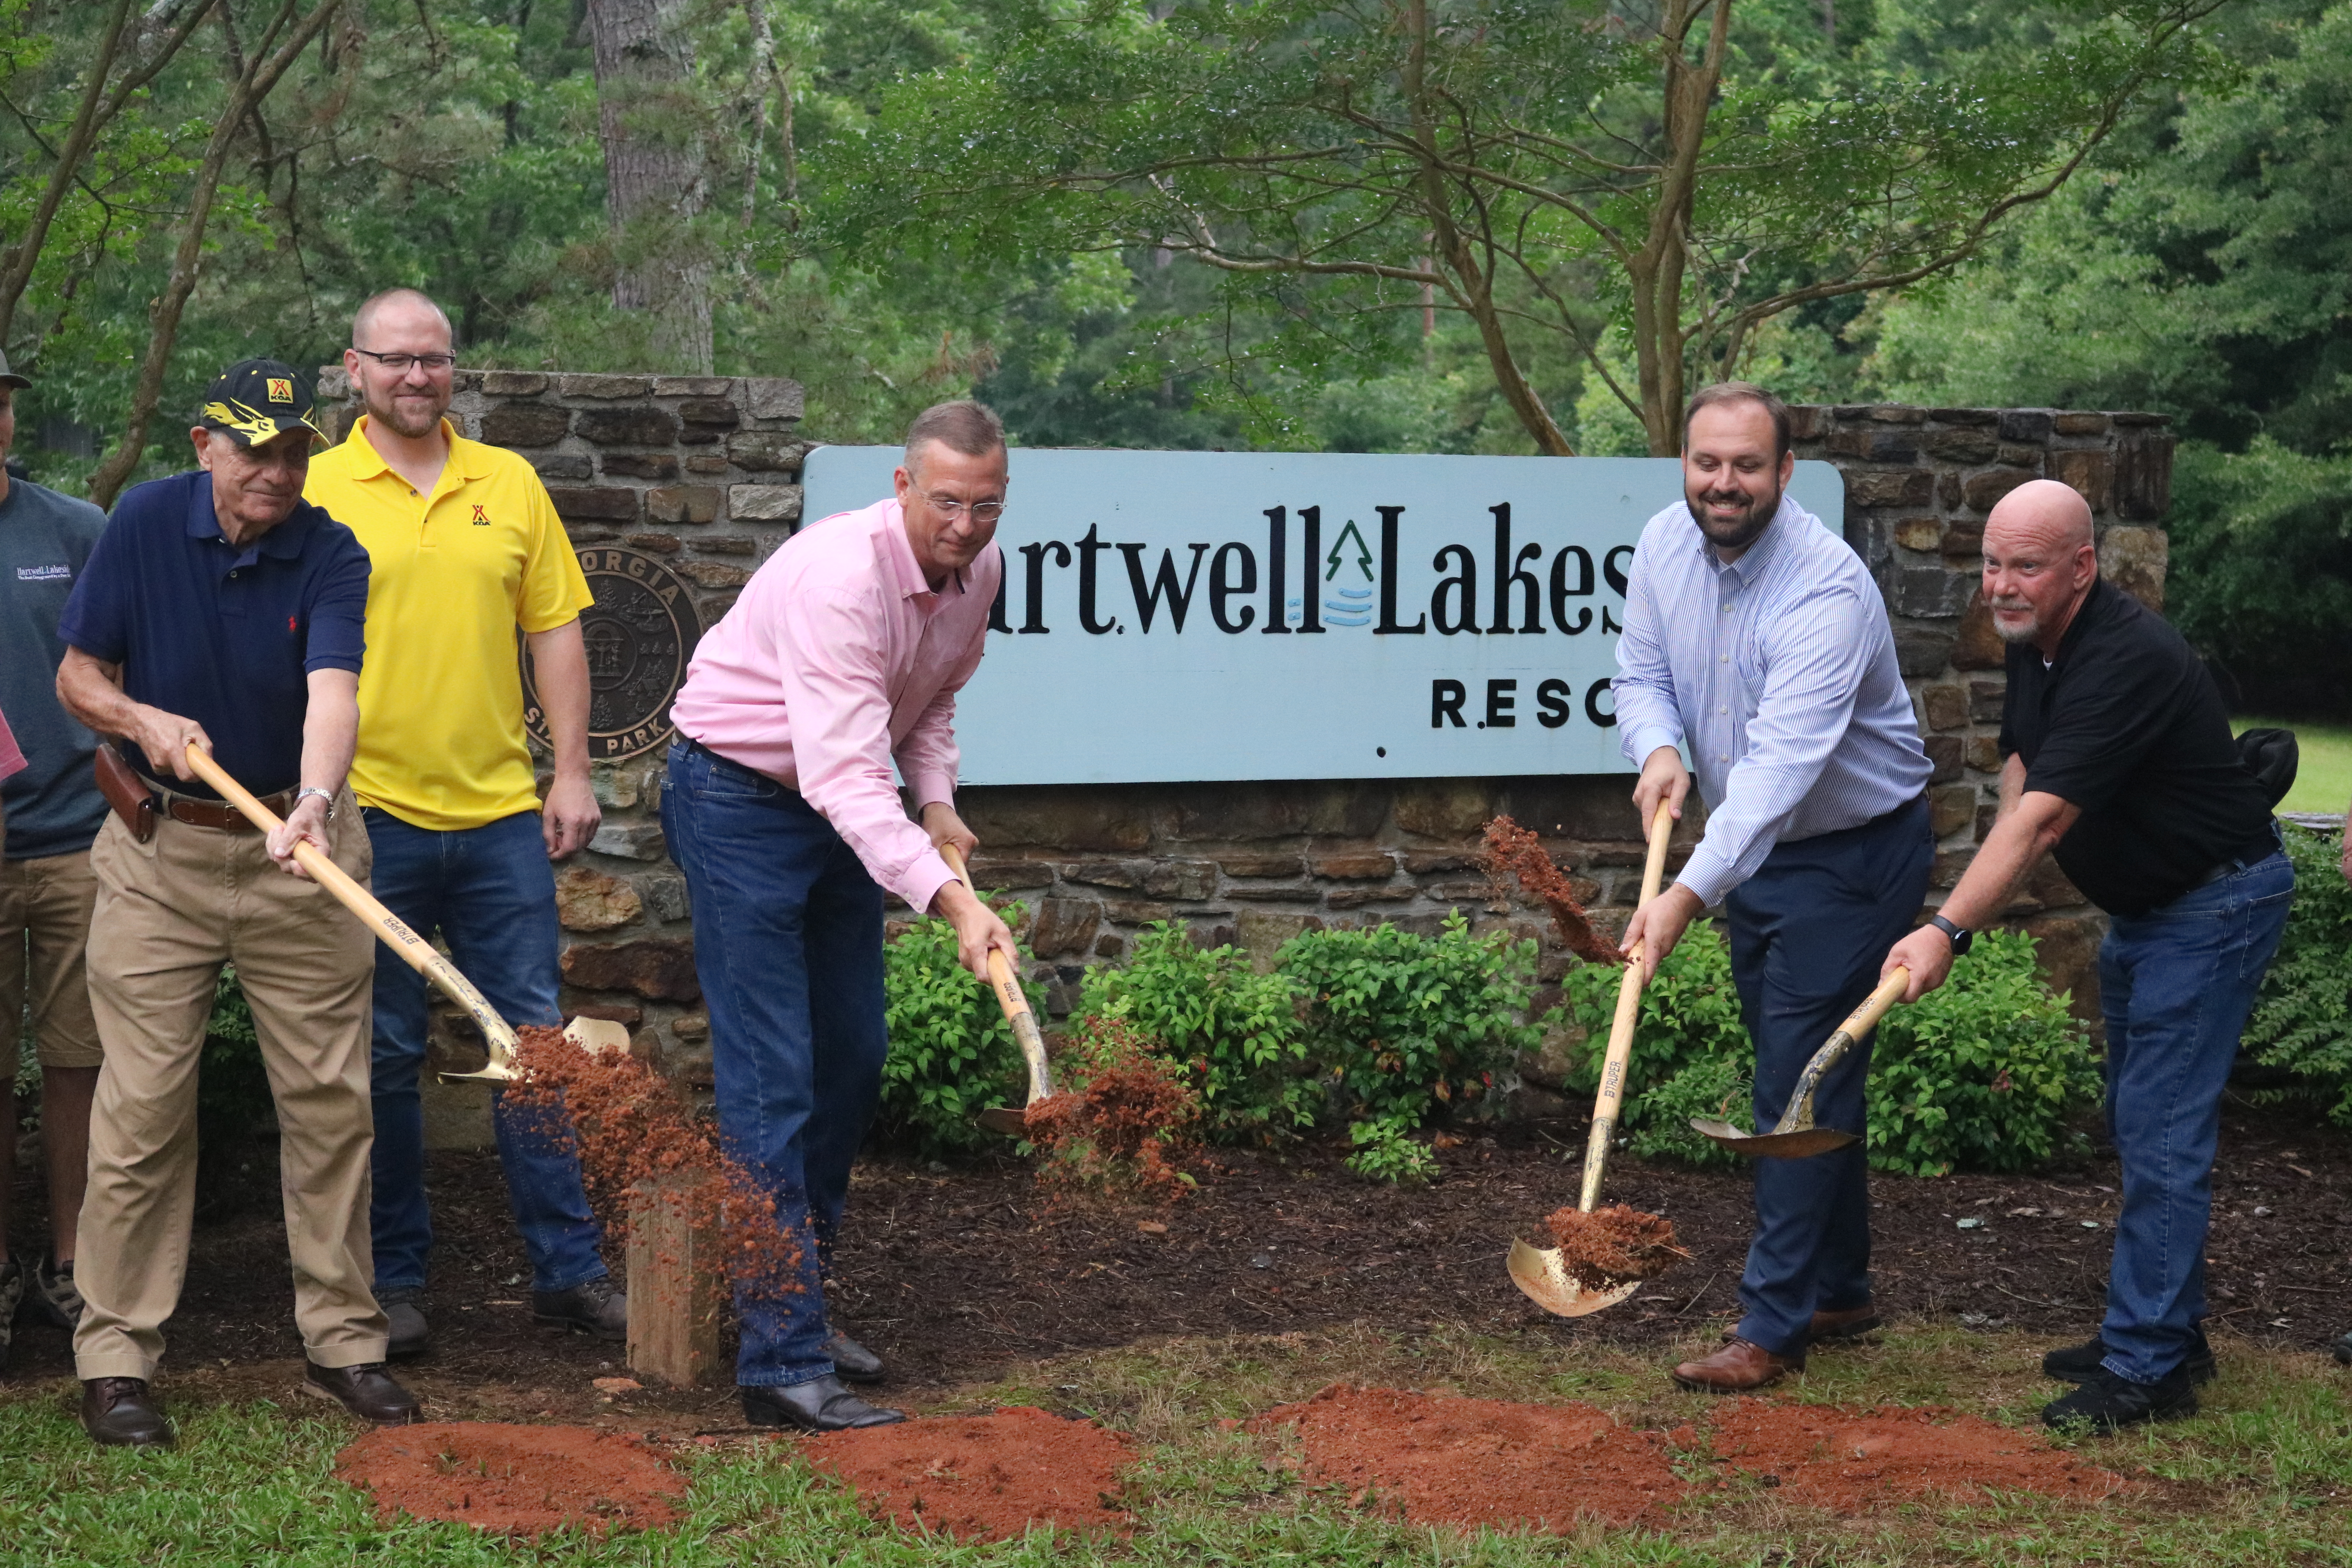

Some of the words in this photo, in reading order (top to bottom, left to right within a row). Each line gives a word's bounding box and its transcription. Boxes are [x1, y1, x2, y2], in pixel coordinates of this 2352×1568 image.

[17, 566, 44, 575] Hartwell
[581, 551, 679, 605] ORGIA
[986, 505, 1326, 635] rtwell
[1373, 502, 1635, 635] Lakes
[1432, 678, 1617, 728] RESO
[607, 720, 666, 755] PARK
[383, 916, 414, 941] TRUPER
[1853, 998, 1877, 1016] TRUPER
[1606, 1061, 1621, 1091] TRUPER
